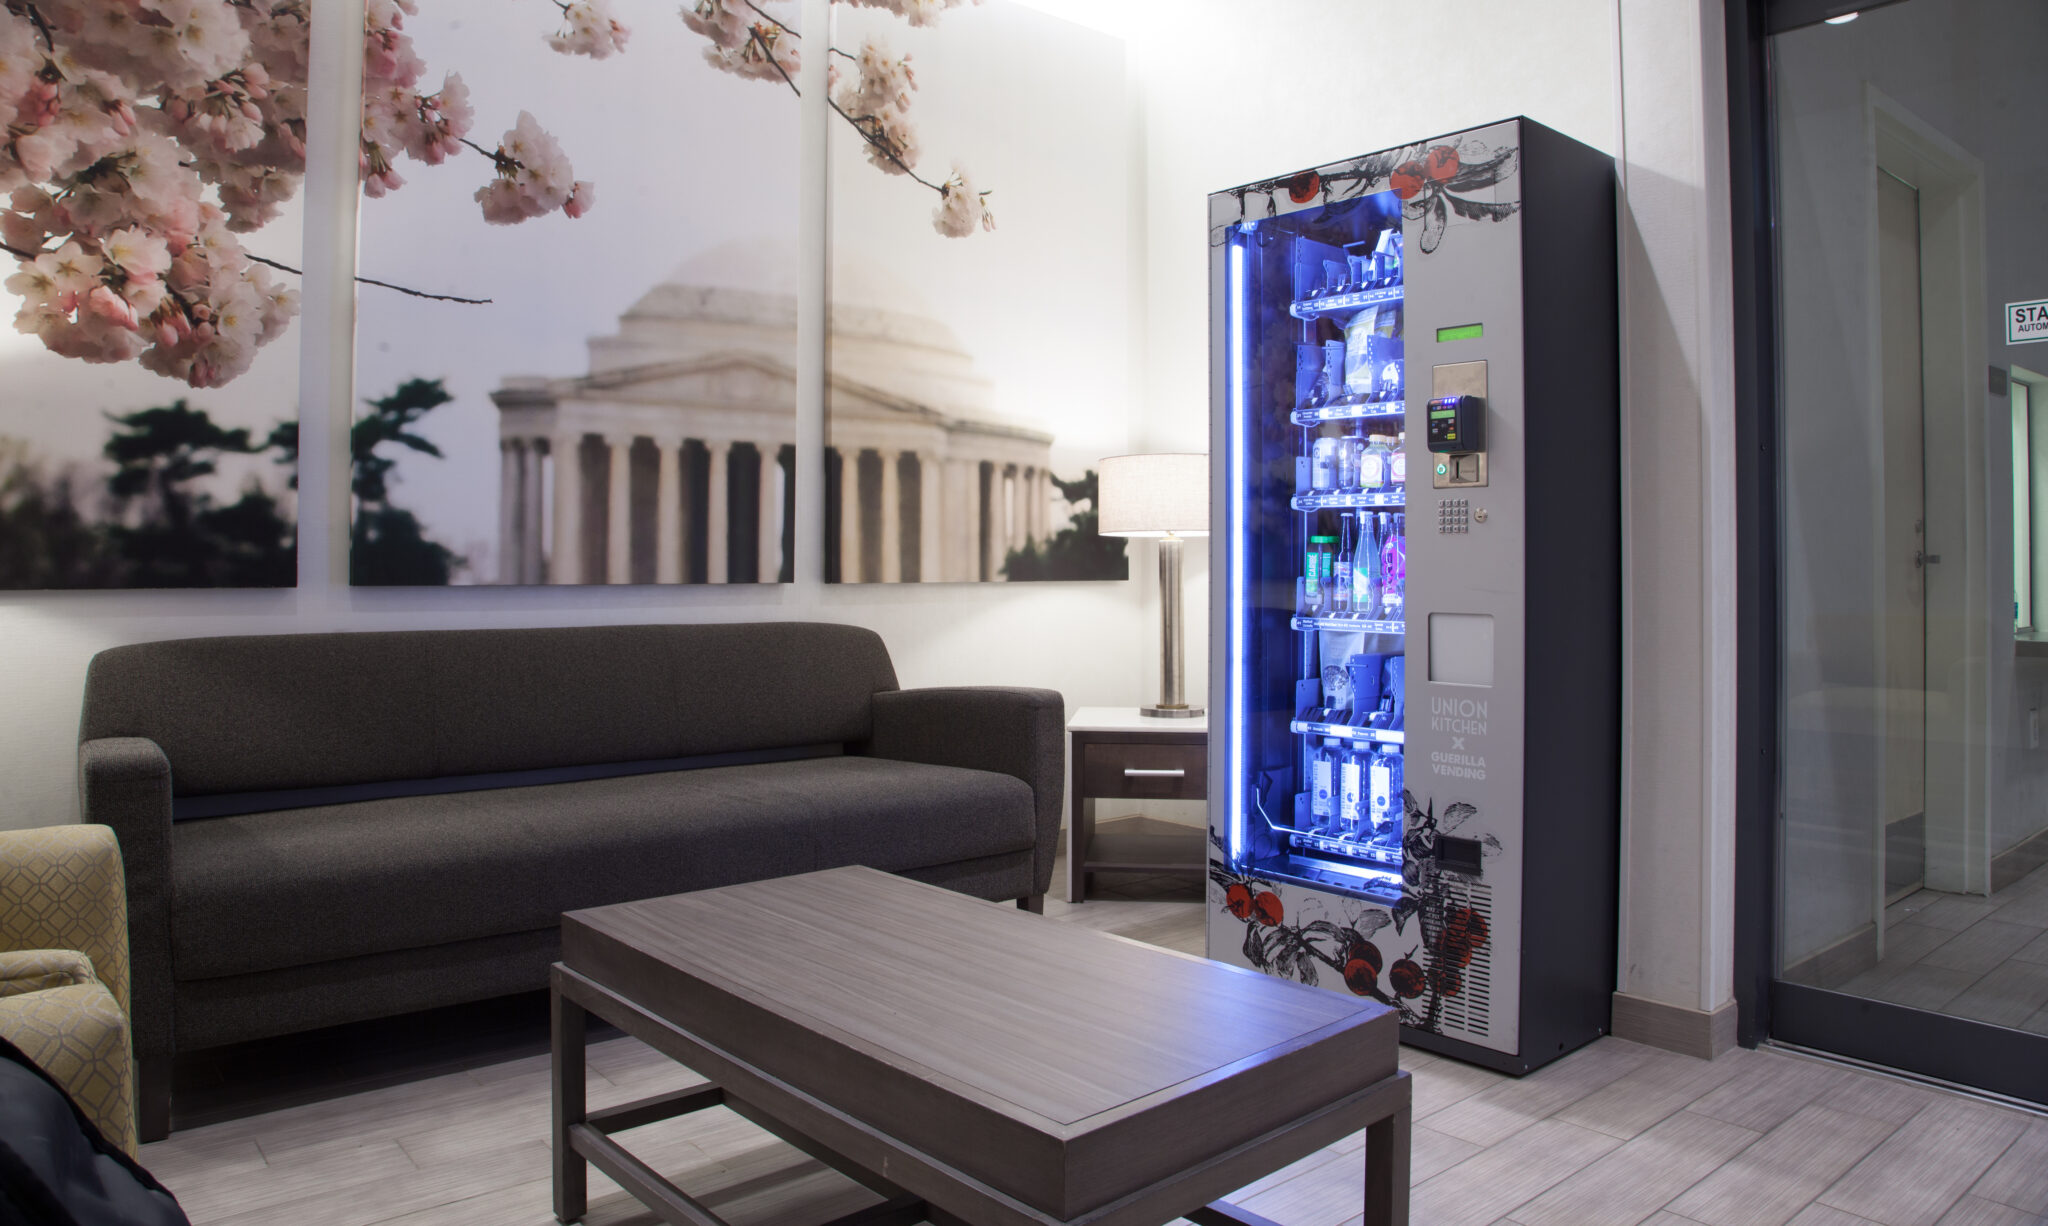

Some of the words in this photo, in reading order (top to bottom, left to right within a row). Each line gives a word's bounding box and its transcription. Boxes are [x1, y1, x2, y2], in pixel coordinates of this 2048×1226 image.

[1431, 696, 1488, 719] UNION
[1431, 716, 1487, 736] KITCHEN
[1431, 751, 1486, 768] GUERILLA
[1432, 764, 1486, 780] VENDING
